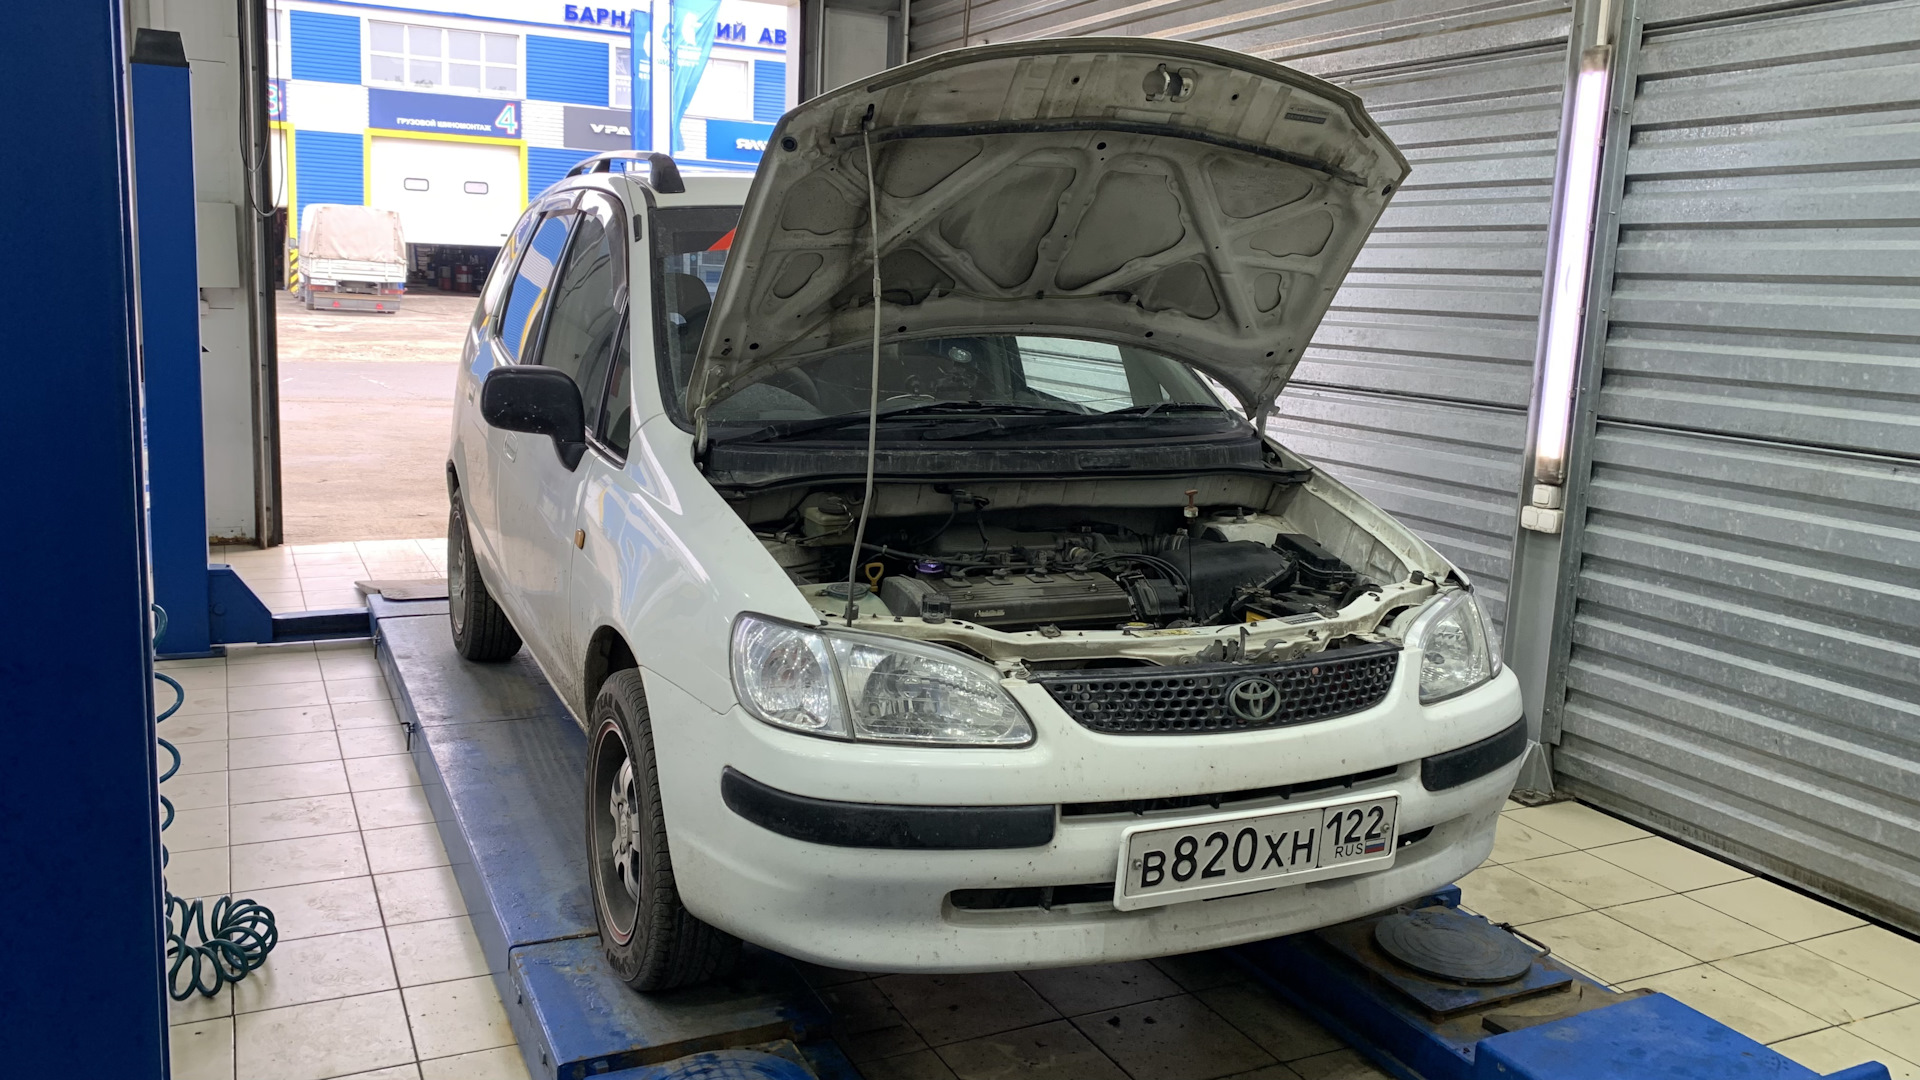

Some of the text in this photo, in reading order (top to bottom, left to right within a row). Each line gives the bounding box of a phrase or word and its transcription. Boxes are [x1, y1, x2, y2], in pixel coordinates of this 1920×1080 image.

[396, 117, 492, 132] ГРУЗОВОЙ ШИНОМОНТАЖ
[494, 103, 519, 135] 4
[1326, 805, 1384, 846] 122
[1140, 826, 1315, 888] В820ХН
[1333, 841, 1363, 859] RUS
